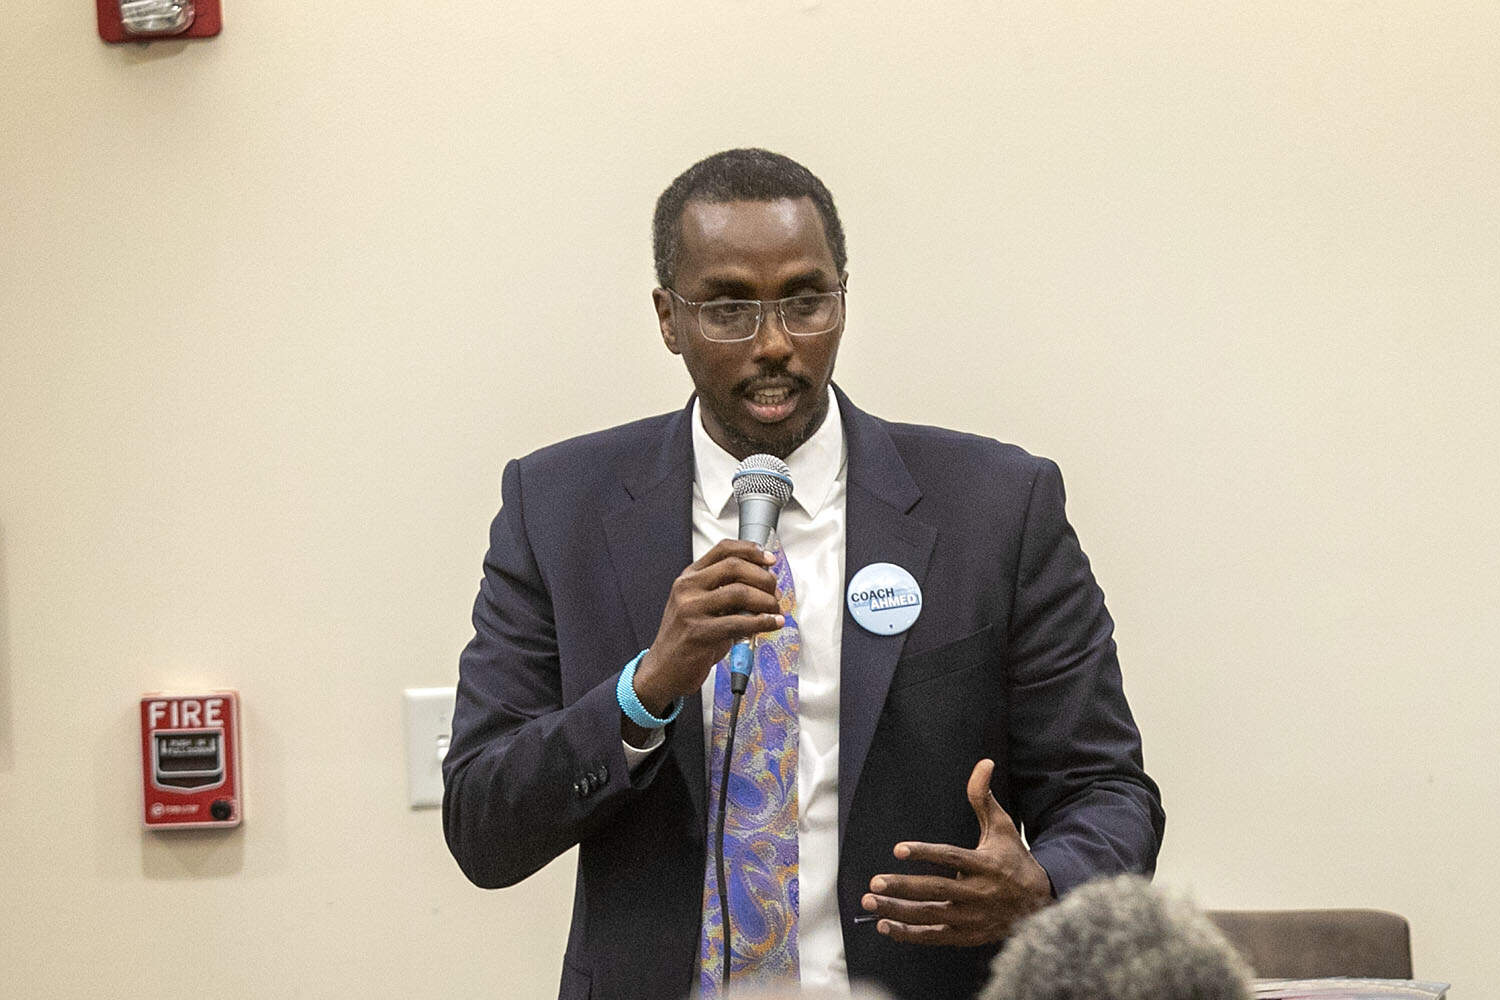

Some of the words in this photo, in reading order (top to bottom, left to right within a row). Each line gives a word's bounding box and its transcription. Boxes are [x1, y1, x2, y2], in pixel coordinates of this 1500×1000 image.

[851, 587, 895, 603] COACH
[871, 593, 918, 611] AHMED
[148, 698, 225, 728] FIRE
